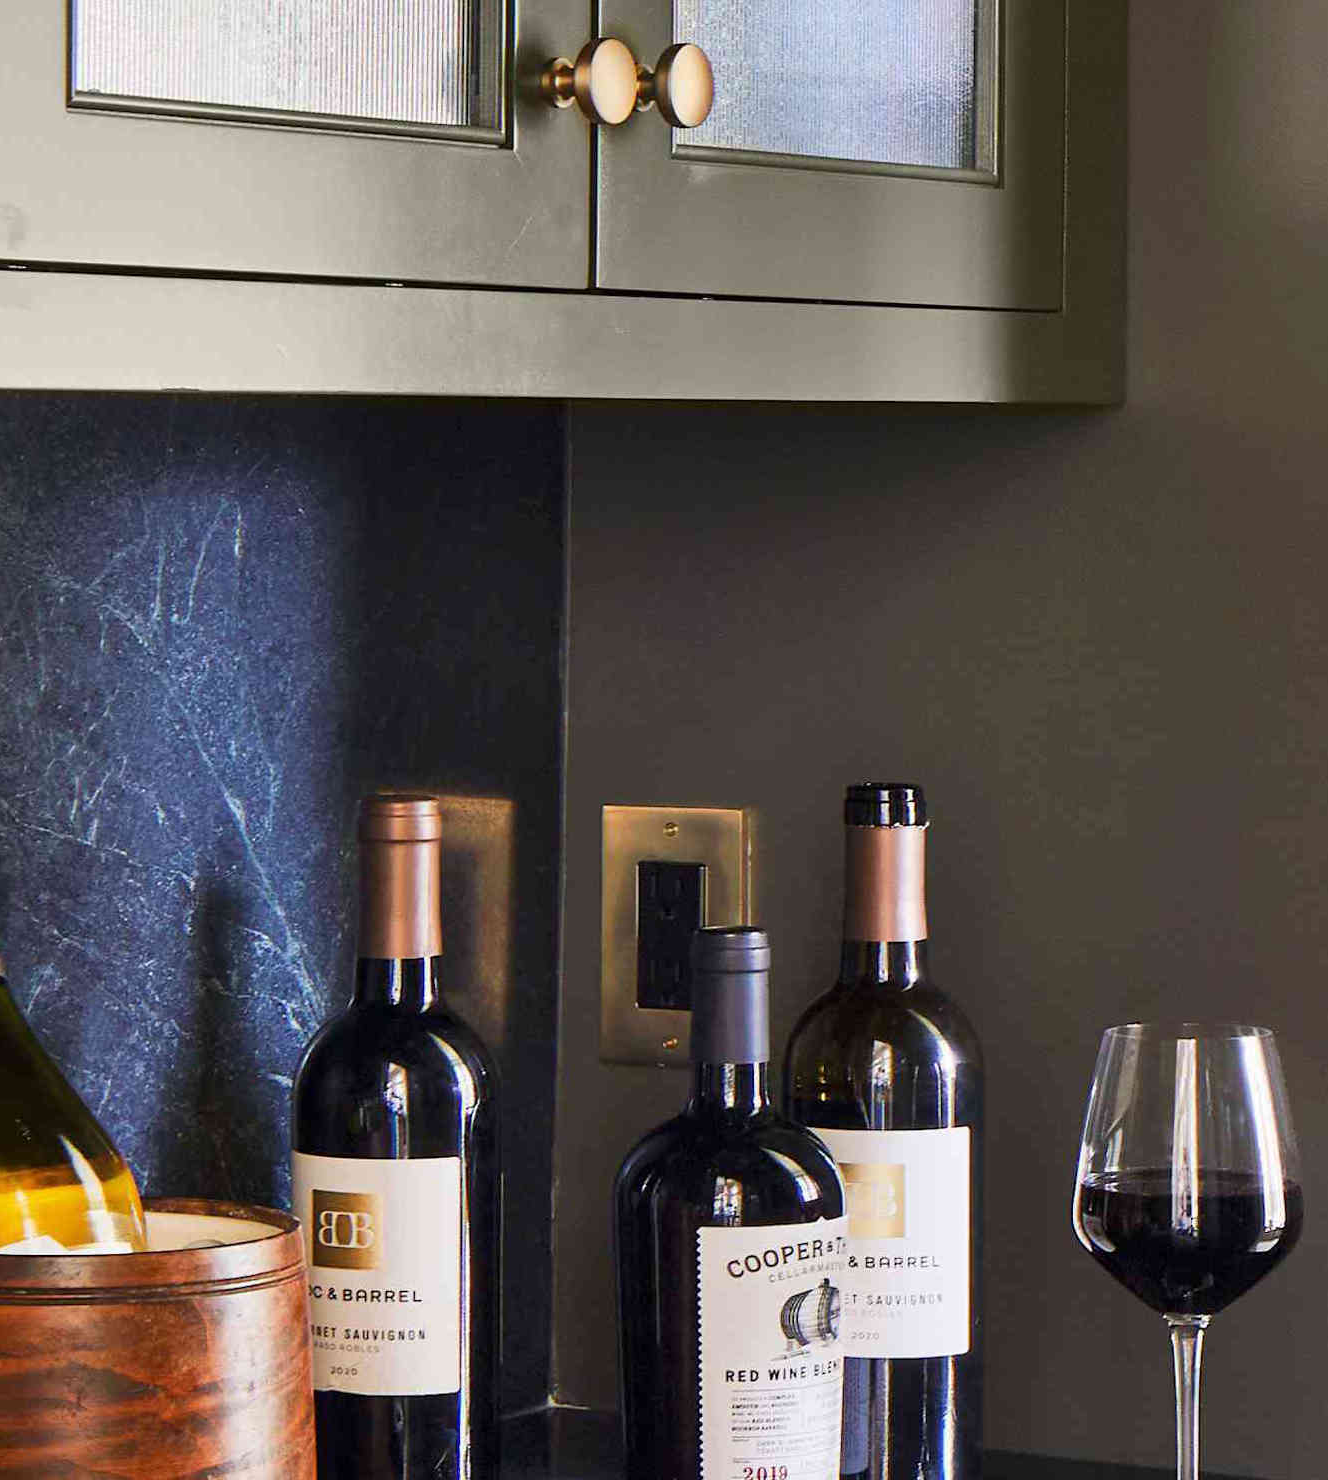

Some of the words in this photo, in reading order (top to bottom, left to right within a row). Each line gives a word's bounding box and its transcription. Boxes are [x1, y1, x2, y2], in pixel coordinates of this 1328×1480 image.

[727, 1239, 824, 1279] COOPER
[848, 1255, 859, 1268] &
[864, 1256, 941, 1269] BARREL
[327, 1287, 338, 1300] &
[342, 1288, 423, 1303] BARREL
[343, 1328, 426, 1341] SAUVIGNON
[725, 1370, 760, 1383] RED
[768, 1366, 808, 1381] WINE
